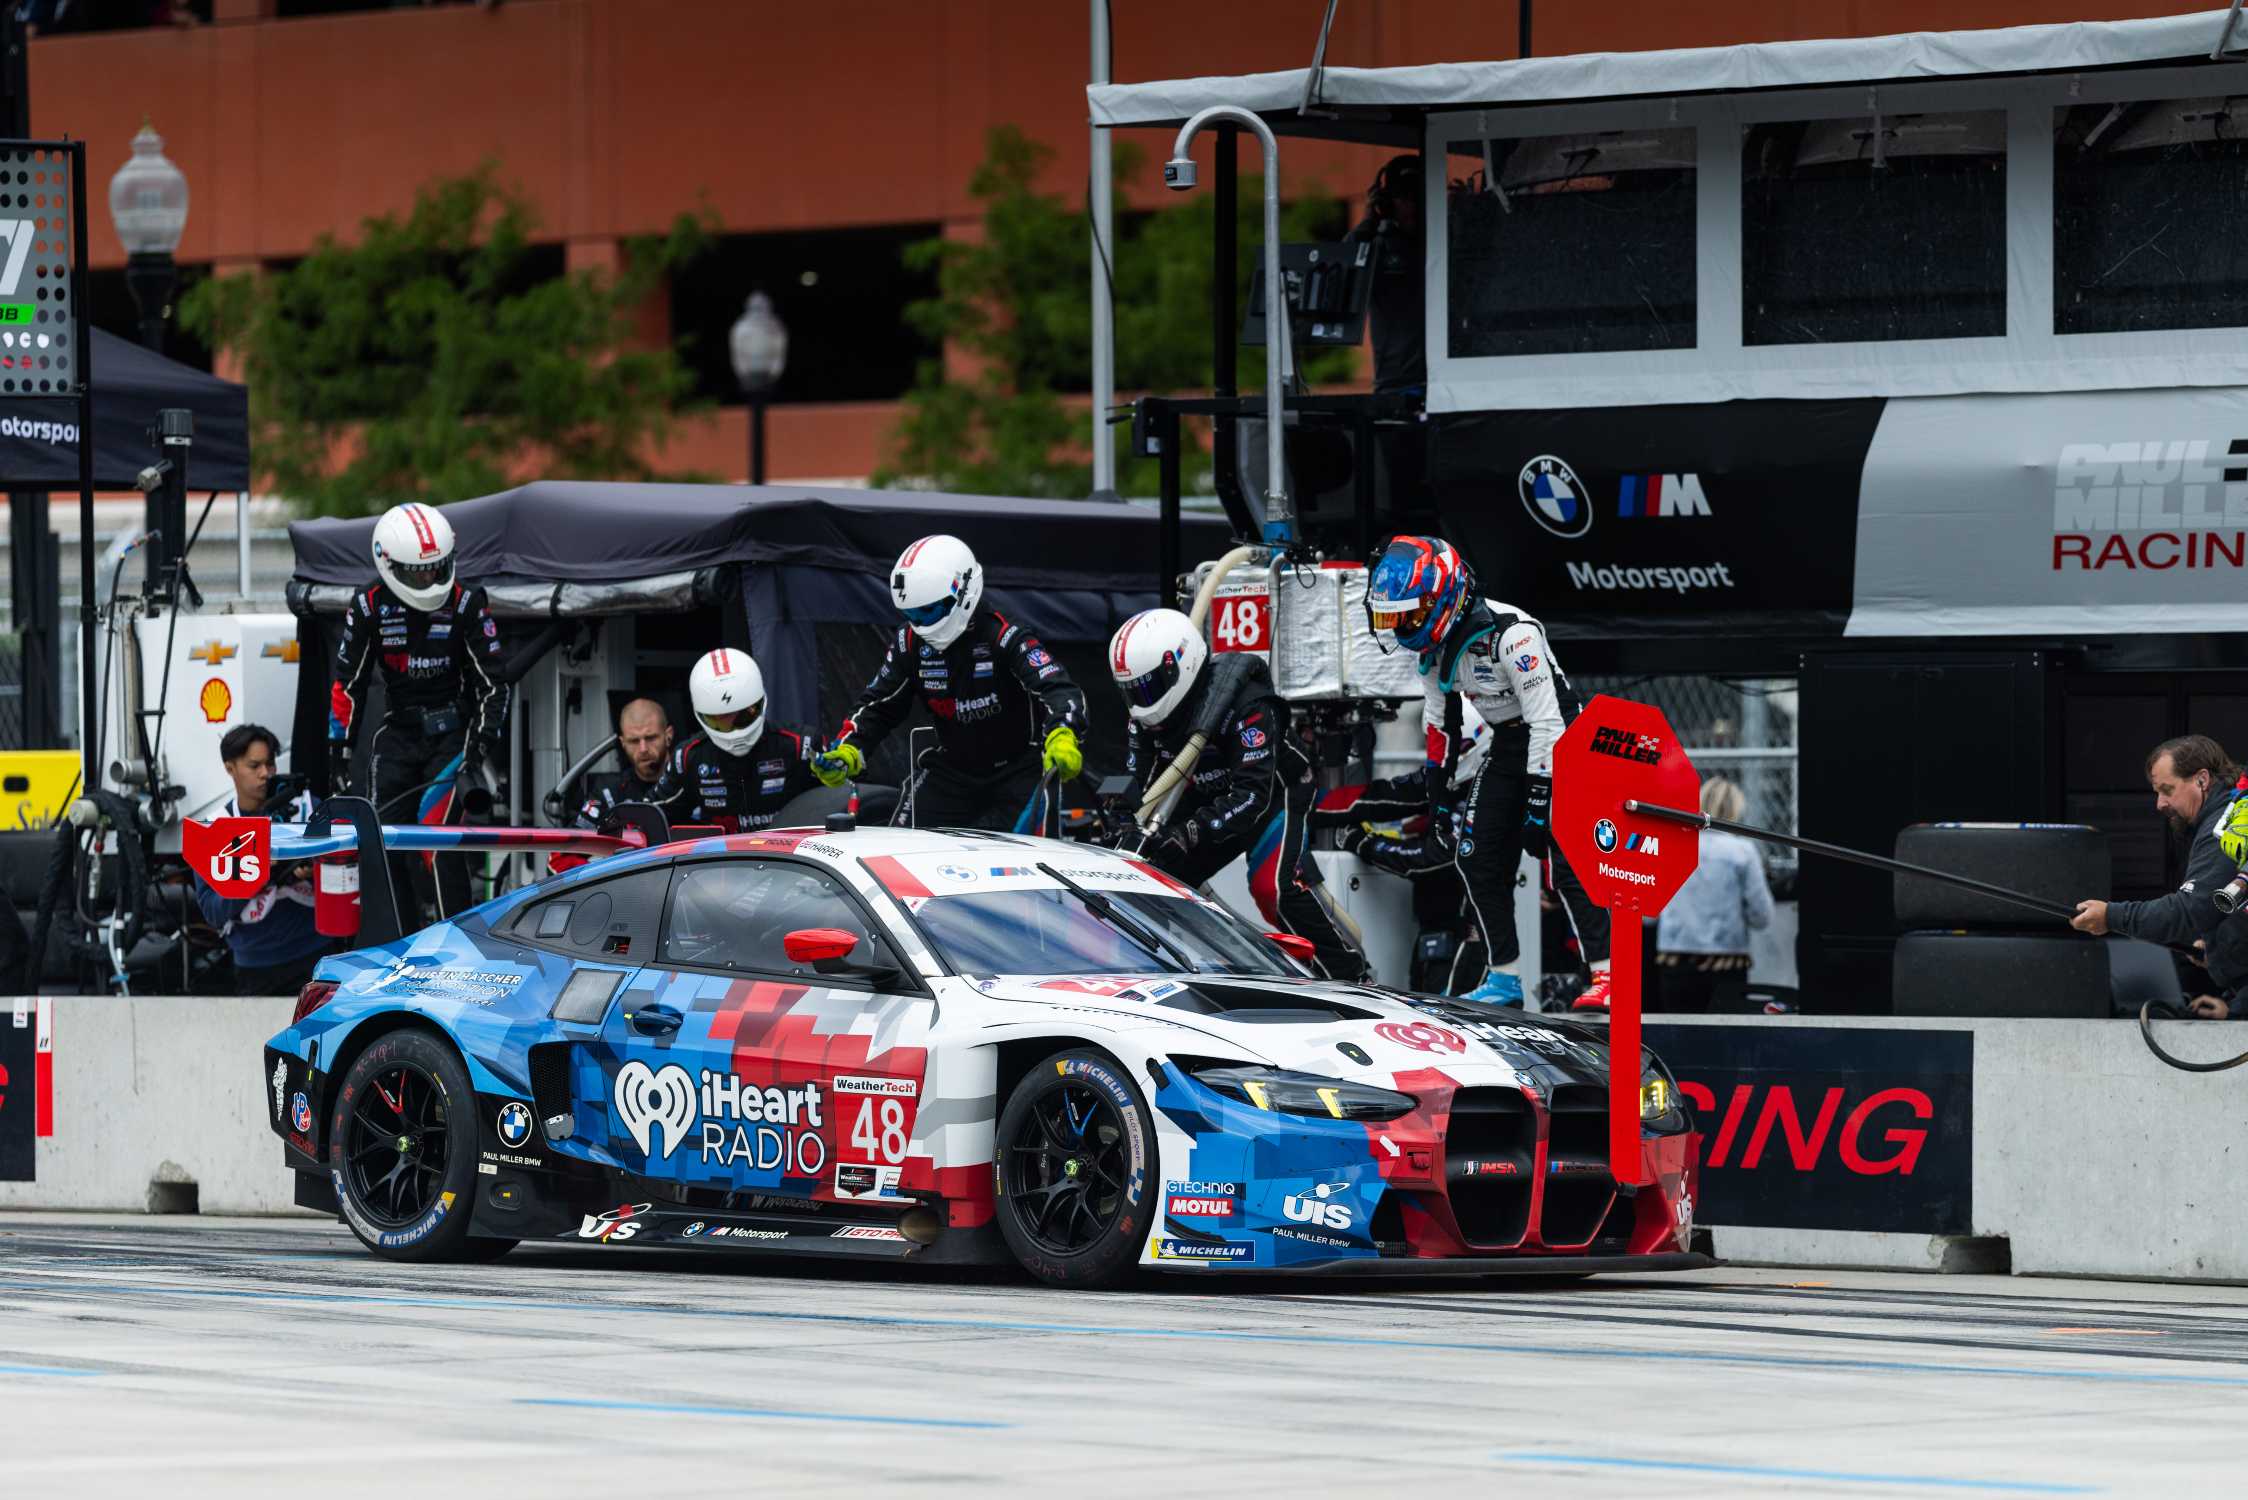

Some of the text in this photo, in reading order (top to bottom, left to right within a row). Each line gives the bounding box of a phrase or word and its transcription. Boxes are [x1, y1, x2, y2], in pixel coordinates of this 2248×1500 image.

[2056, 440, 2220, 487] PAUL
[2053, 484, 2248, 531] MILLE
[2053, 531, 2247, 571] RACIN
[1566, 561, 1735, 594] Motorsport
[1215, 584, 1267, 595] eatherTech
[1217, 600, 1260, 647] 48
[954, 691, 999, 713] iHeart
[1596, 726, 1639, 746] PAUL
[1589, 739, 1663, 767] MILLER
[811, 841, 845, 859] HARPER
[1059, 868, 1147, 882] otorsport
[1598, 862, 1656, 886] Motorsport
[411, 971, 523, 986] AUSTIN HATCHER
[836, 1078, 915, 1094] WeatherTech
[1076, 1061, 1128, 1103] MICHELIN
[701, 1069, 823, 1128] iHeart
[851, 1096, 908, 1164] 48
[1126, 1111, 1138, 1134] PILOT
[483, 1151, 542, 1167] PAUL MILLER BMW
[702, 1122, 826, 1175] RADIO
[1479, 1161, 1518, 1176] IMSA
[1166, 1180, 1236, 1195] GTECHNIQ
[1171, 1199, 1231, 1215] MOTUL
[1282, 1194, 1353, 1230] UIS
[383, 1213, 438, 1246] MICHELIN
[729, 1227, 790, 1240] Motorsport
[850, 1228, 904, 1239] GTD PR
[1272, 1227, 1351, 1248] PAUL MILLER BMW
[1178, 1246, 1247, 1256] MICHELIN
